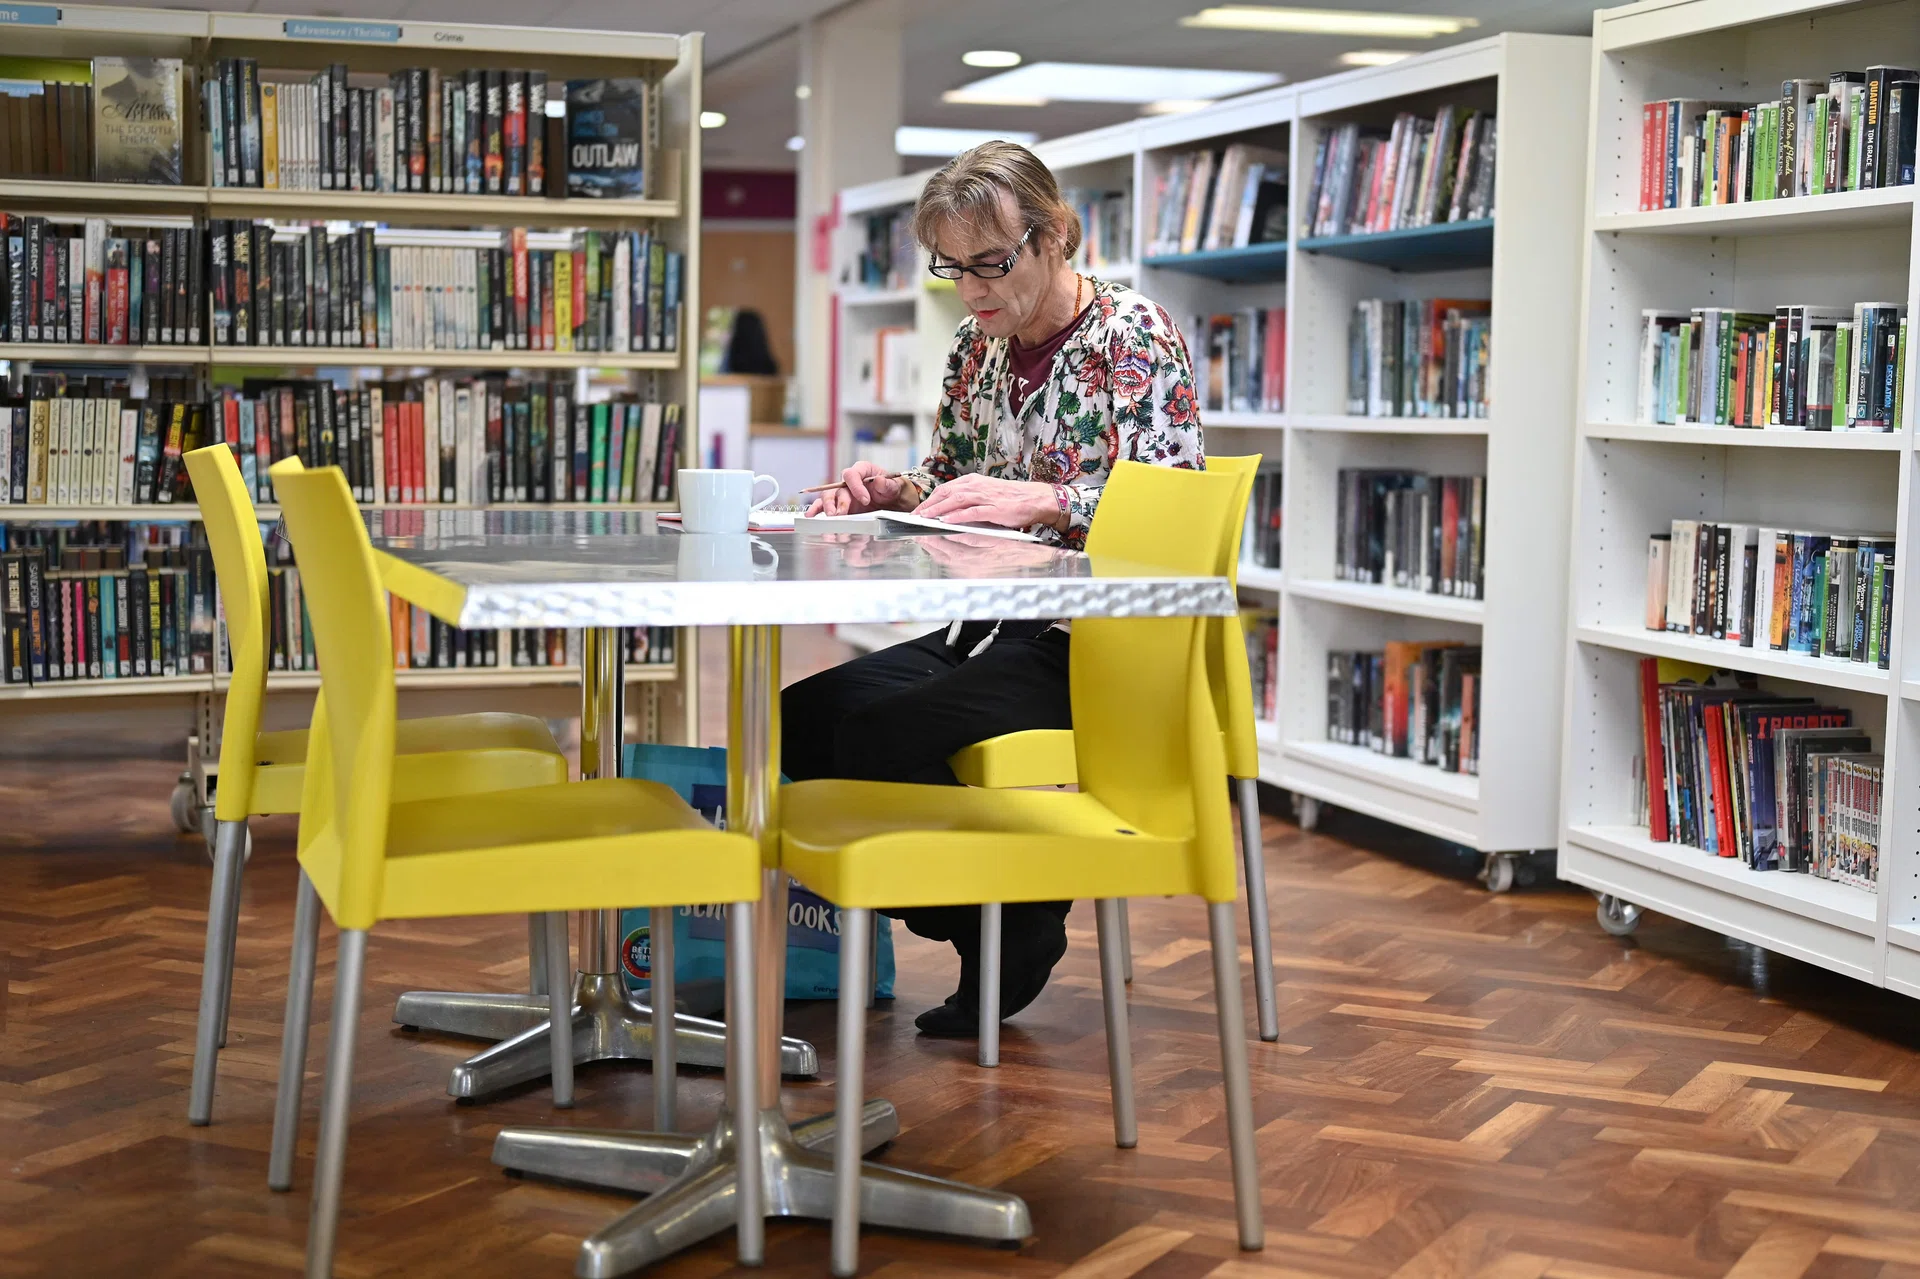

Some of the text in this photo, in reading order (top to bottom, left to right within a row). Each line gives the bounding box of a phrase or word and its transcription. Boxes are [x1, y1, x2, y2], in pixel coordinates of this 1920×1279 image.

[434, 31, 465, 42] Crime
[409, 71, 422, 141] Karin Slaughter
[1786, 106, 1796, 123] One
[1868, 80, 1879, 125] QUANTUM
[106, 124, 173, 136] THE FOURTH
[1785, 123, 1795, 140] Pair
[572, 143, 640, 168] OUTLAW
[1785, 151, 1794, 176] Hands
[1866, 145, 1874, 167] GRACE
[1773, 380, 1781, 413] JOHANSEN
[1884, 364, 1894, 408] DESOLATION
[1786, 387, 1794, 420] JOHANSEN
[32, 415, 45, 447] ROBB
[8, 561, 21, 613] THE HERMIT
[29, 563, 40, 609] SANDFORD
[1716, 553, 1726, 626] VANESSA SAVAGE
[1859, 583, 1867, 610] Woman
[1871, 596, 1879, 629] STRANGER'S
[33, 633, 42, 657] PREY
[1756, 717, 1767, 740] I
